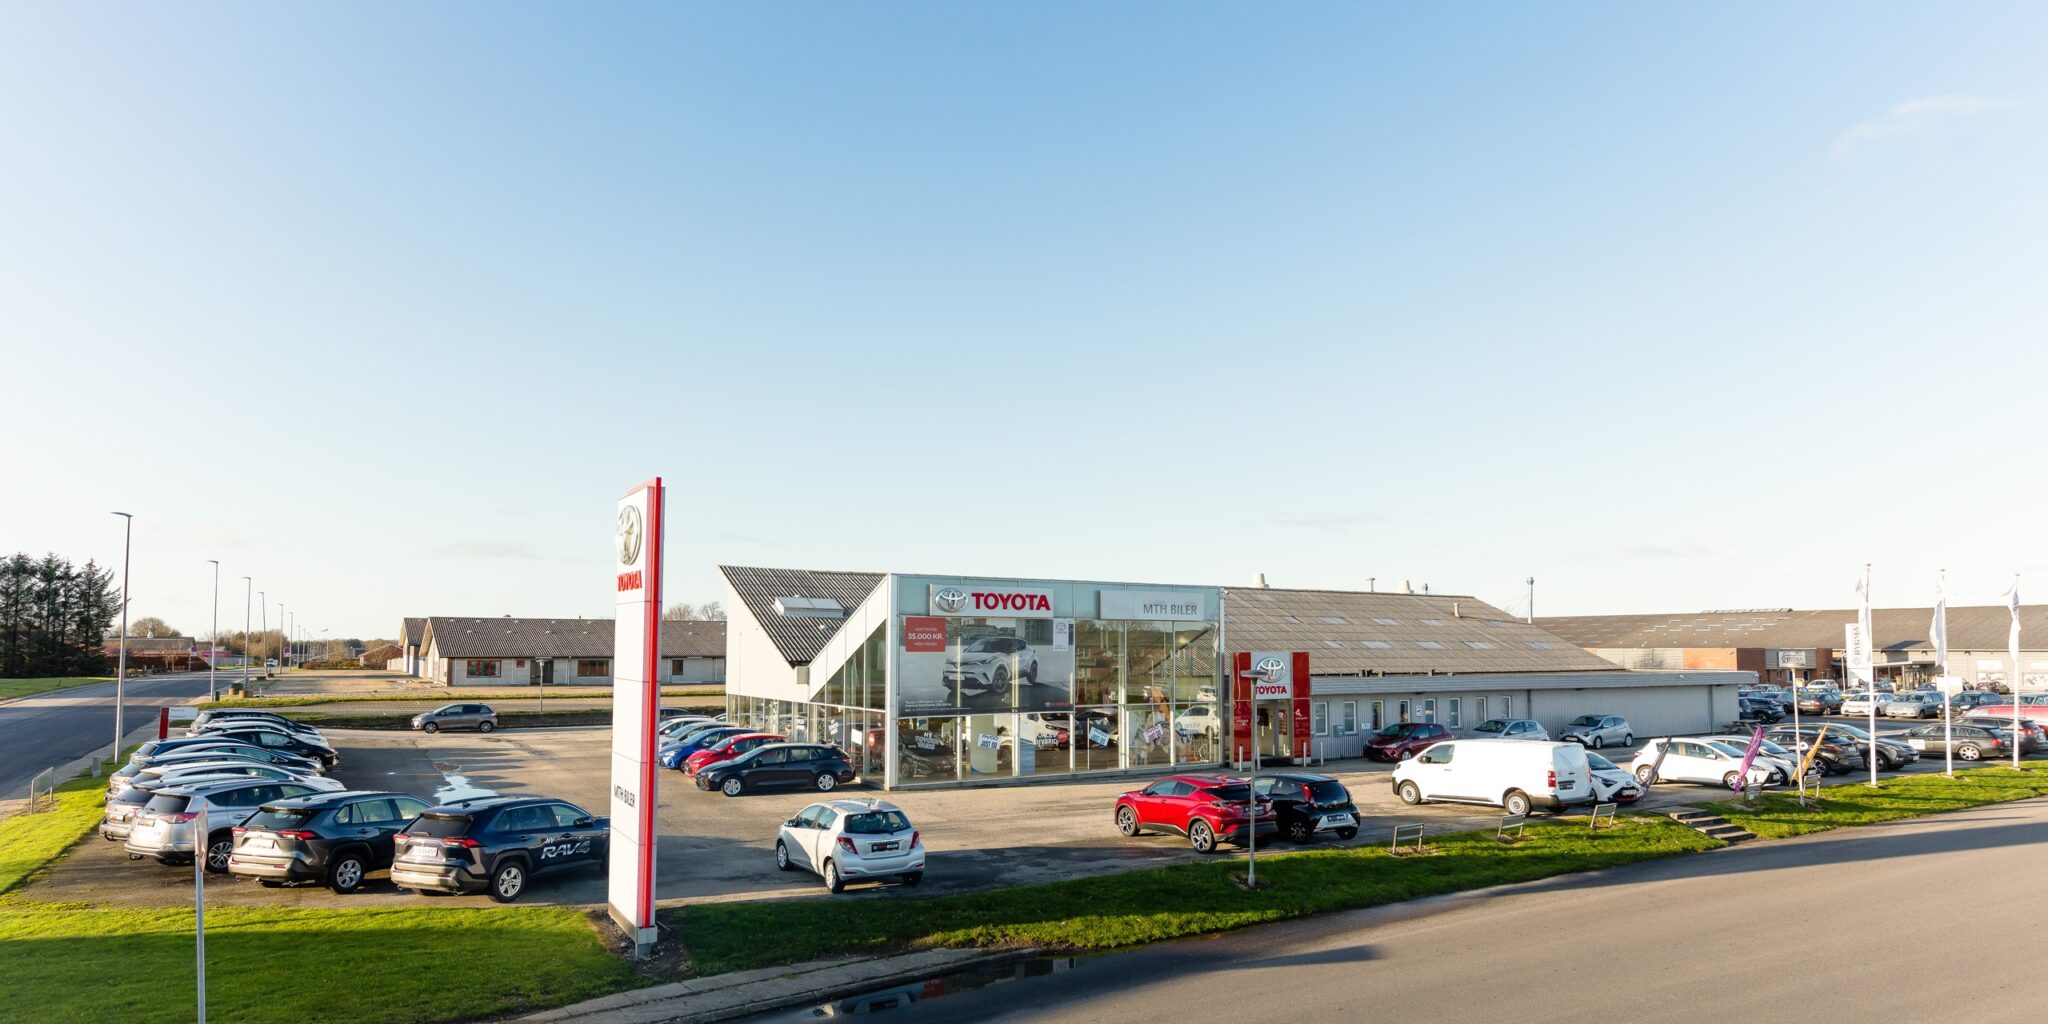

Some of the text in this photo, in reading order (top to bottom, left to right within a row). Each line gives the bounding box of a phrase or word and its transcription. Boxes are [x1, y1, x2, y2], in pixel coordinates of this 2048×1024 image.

[617, 570, 643, 592] TOYOTA
[971, 592, 1051, 611] TOYOTA
[1143, 603, 1197, 615] MTH BILER
[1255, 685, 1287, 695] TOYOTA
[541, 840, 591, 860] RAV4
